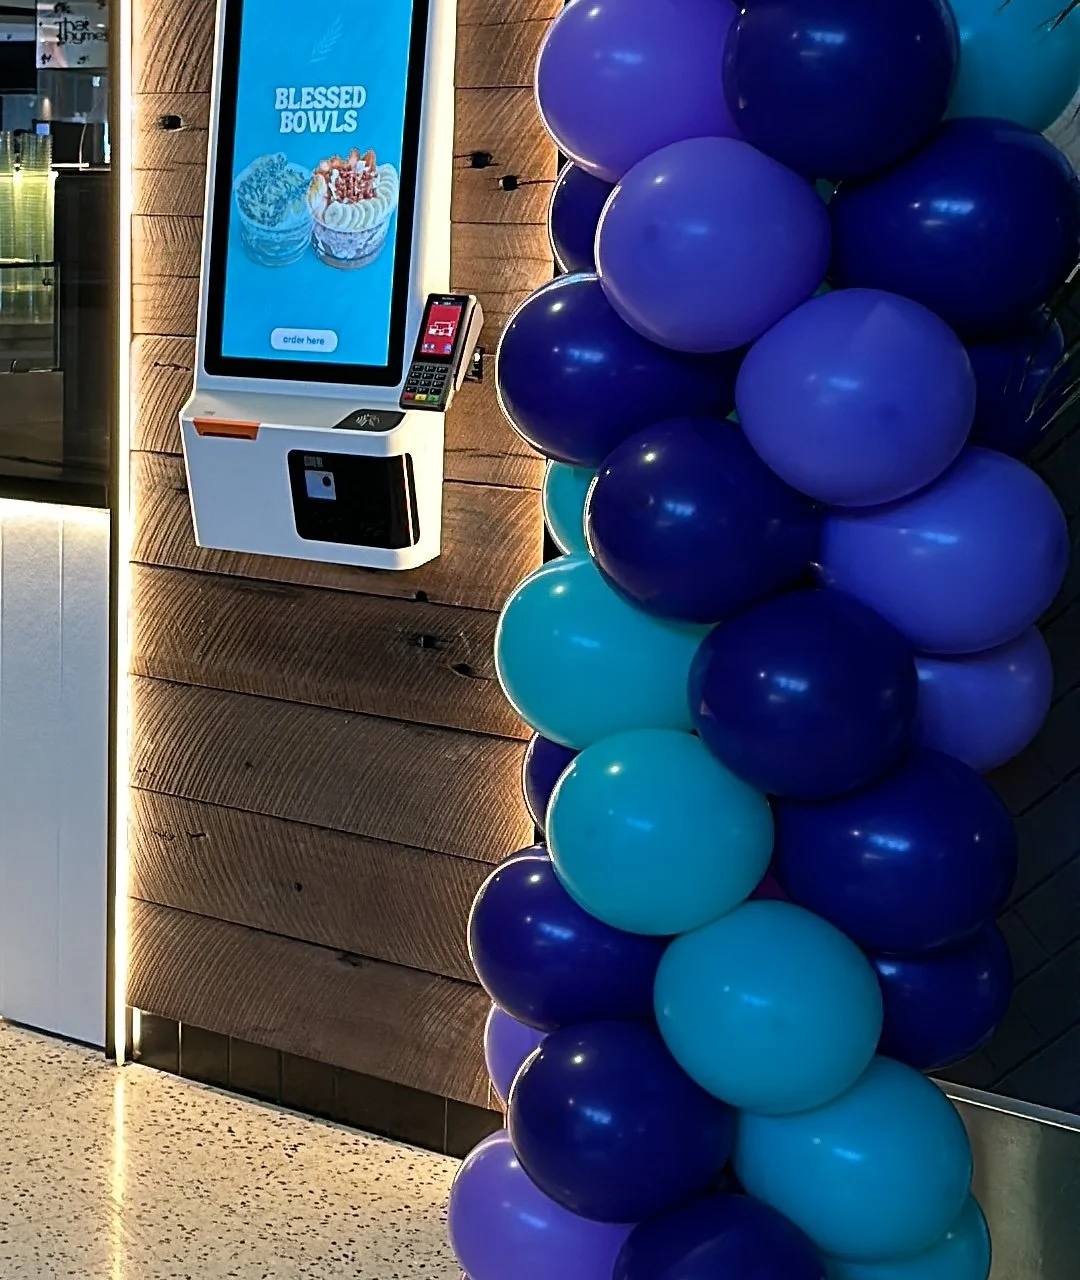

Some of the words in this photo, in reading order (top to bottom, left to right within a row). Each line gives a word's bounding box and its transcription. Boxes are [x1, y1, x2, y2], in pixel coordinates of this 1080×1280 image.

[275, 85, 367, 110] BLESSED
[280, 109, 358, 133] BOWLS
[282, 335, 304, 345] order
[306, 336, 325, 346] here
